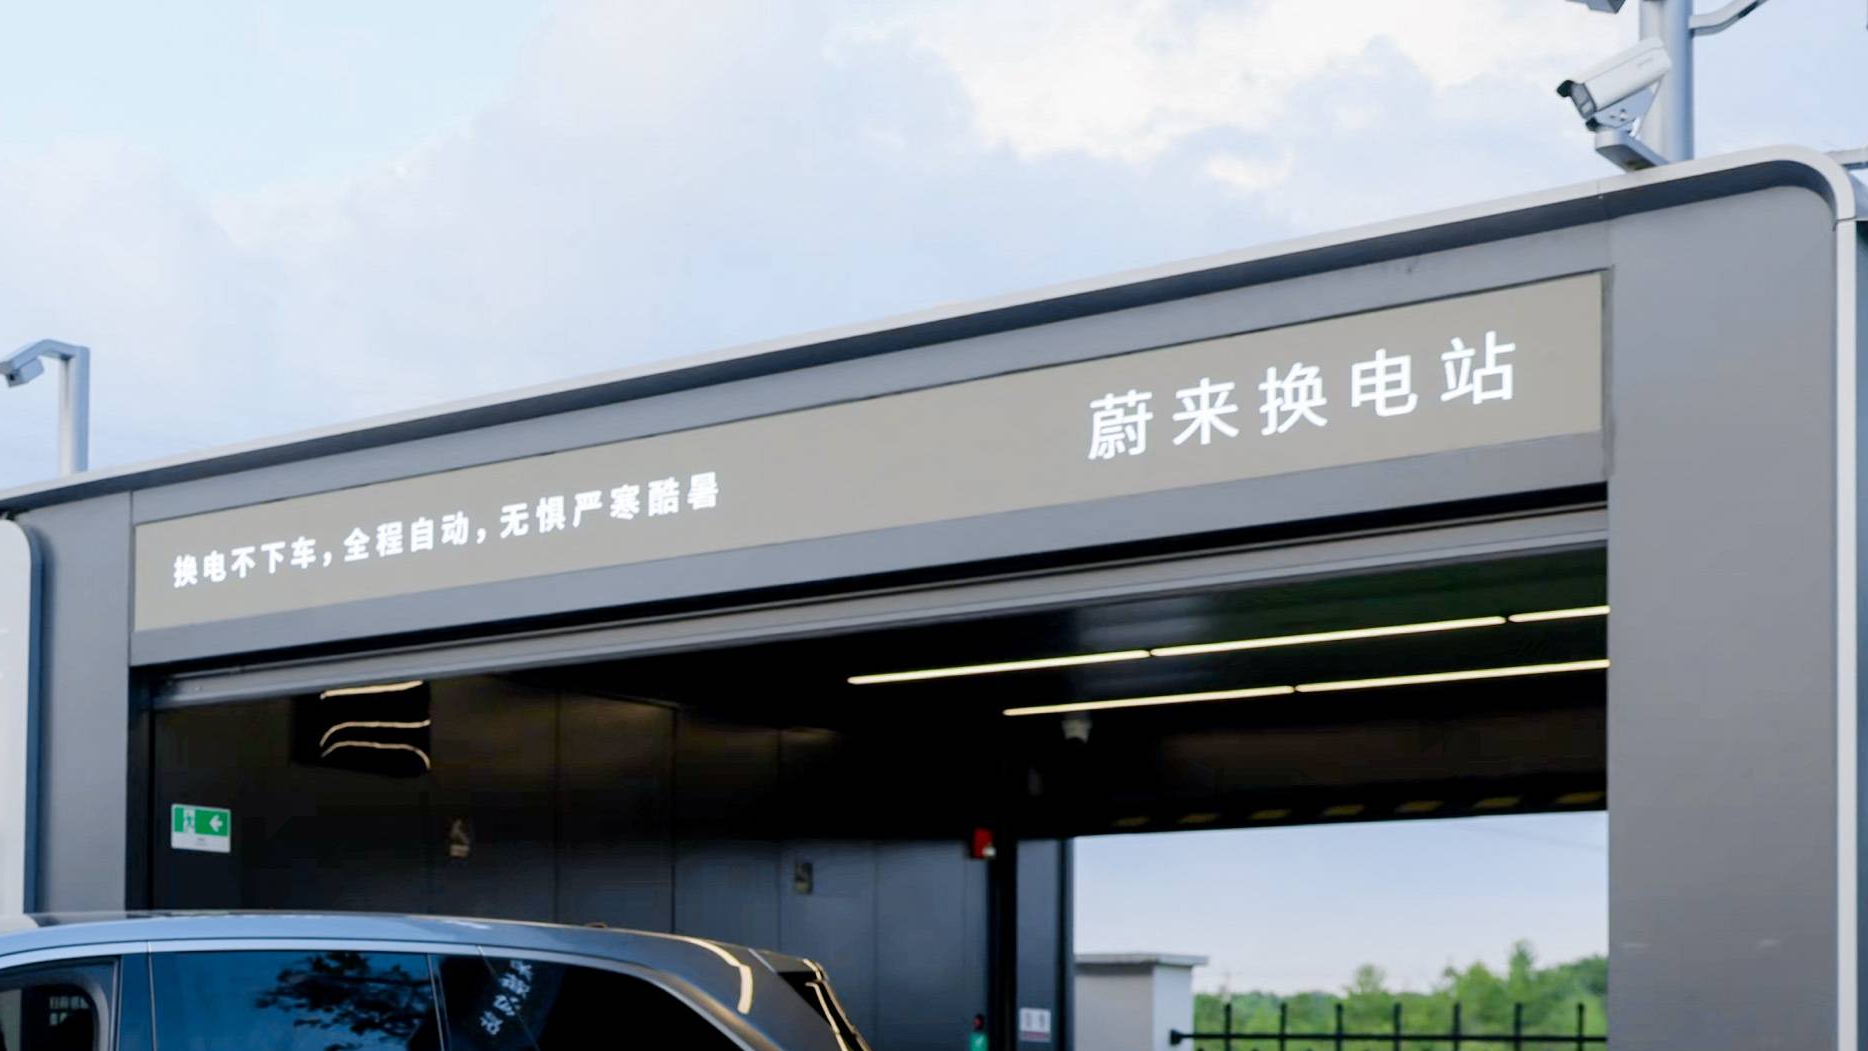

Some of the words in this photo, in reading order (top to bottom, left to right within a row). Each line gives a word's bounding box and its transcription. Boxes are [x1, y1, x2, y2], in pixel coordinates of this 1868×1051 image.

[1088, 331, 1516, 460] 蔚来换电站
